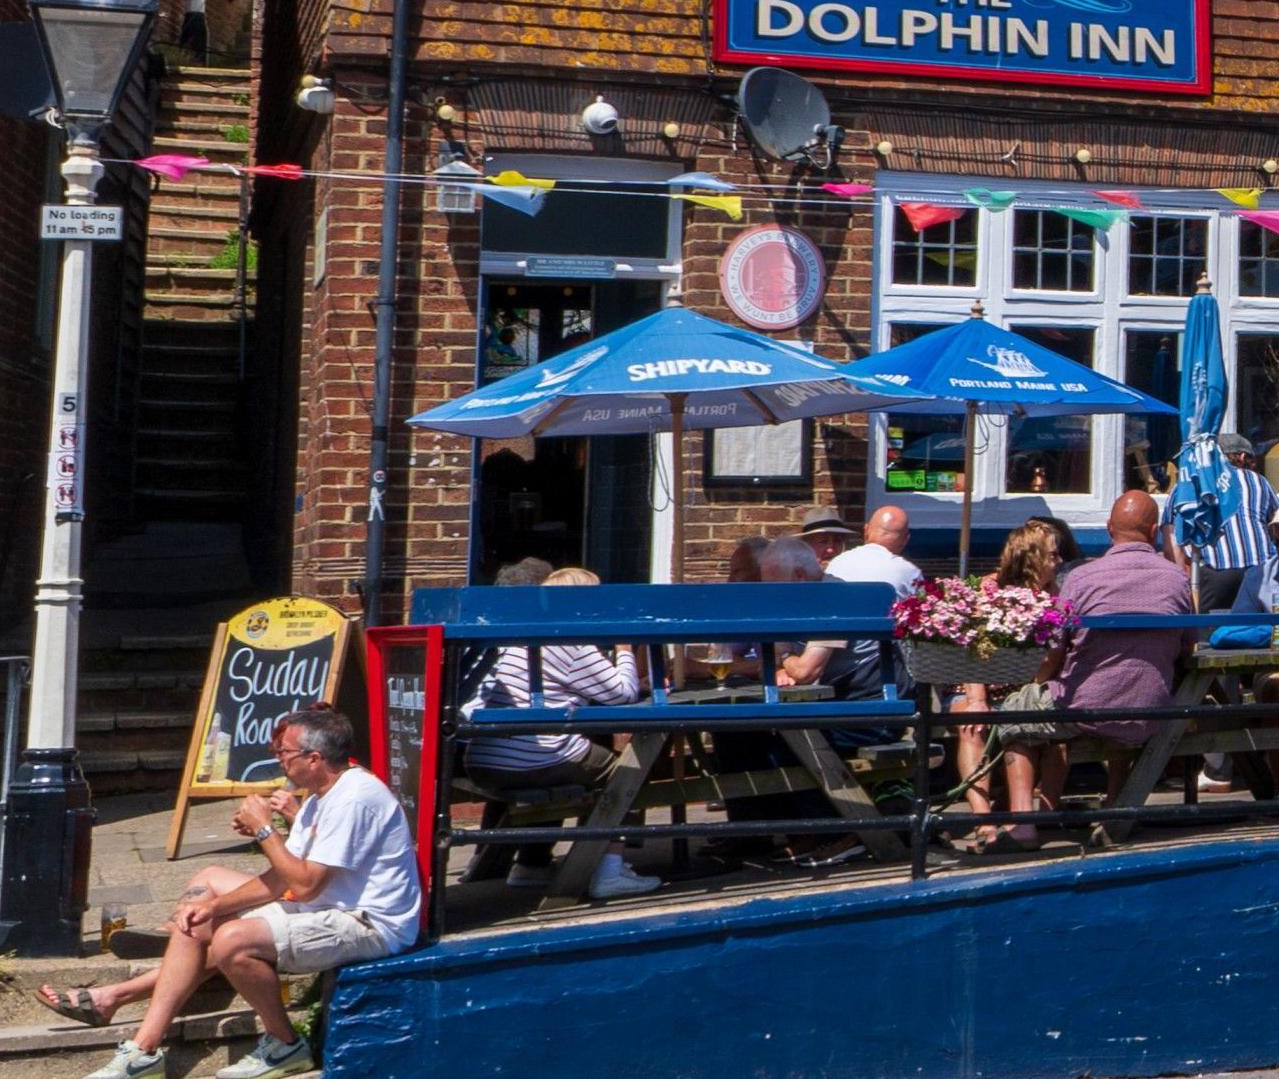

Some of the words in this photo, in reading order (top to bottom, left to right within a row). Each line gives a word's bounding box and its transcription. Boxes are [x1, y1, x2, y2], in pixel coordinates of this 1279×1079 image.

[1070, 22, 1176, 66] INN
[49, 209, 67, 220] No
[70, 209, 116, 222] loading
[46, 224, 57, 234] 11
[60, 226, 78, 234] am
[97, 226, 117, 236] pm
[778, 232, 818, 273] BWERY
[627, 358, 772, 382] SHIPYARD
[949, 378, 1012, 390] PORTLAND
[1016, 380, 1057, 392] MAINE
[1060, 383, 1088, 393] USA
[62, 396, 76, 412] 5
[229, 647, 329, 704] Suday
